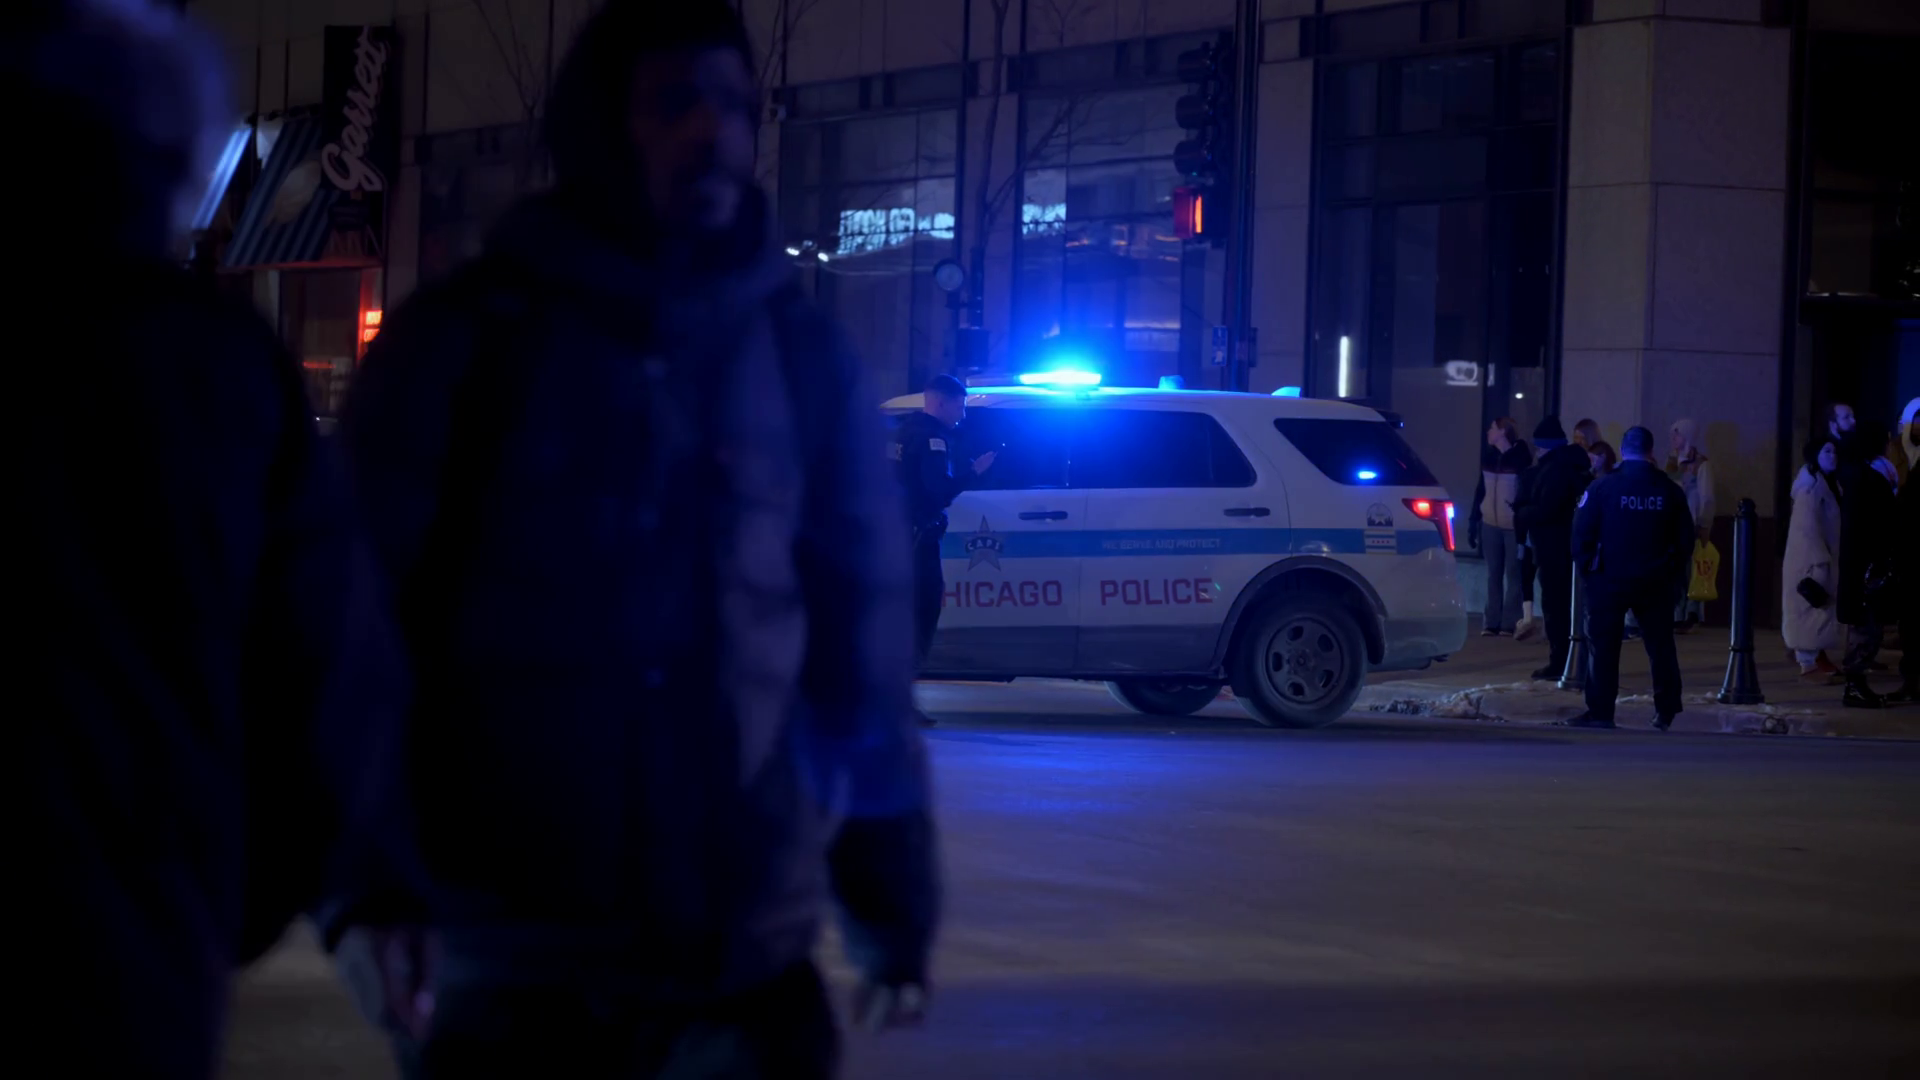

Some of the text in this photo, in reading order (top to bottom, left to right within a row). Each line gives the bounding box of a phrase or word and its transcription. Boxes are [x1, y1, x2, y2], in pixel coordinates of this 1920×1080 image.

[322, 26, 386, 191] Garrett
[1620, 495, 1663, 510] POLICE
[1155, 539, 1175, 549] AND
[1176, 538, 1221, 549] PROTECT
[940, 578, 1213, 607] HICAGO POLICE
